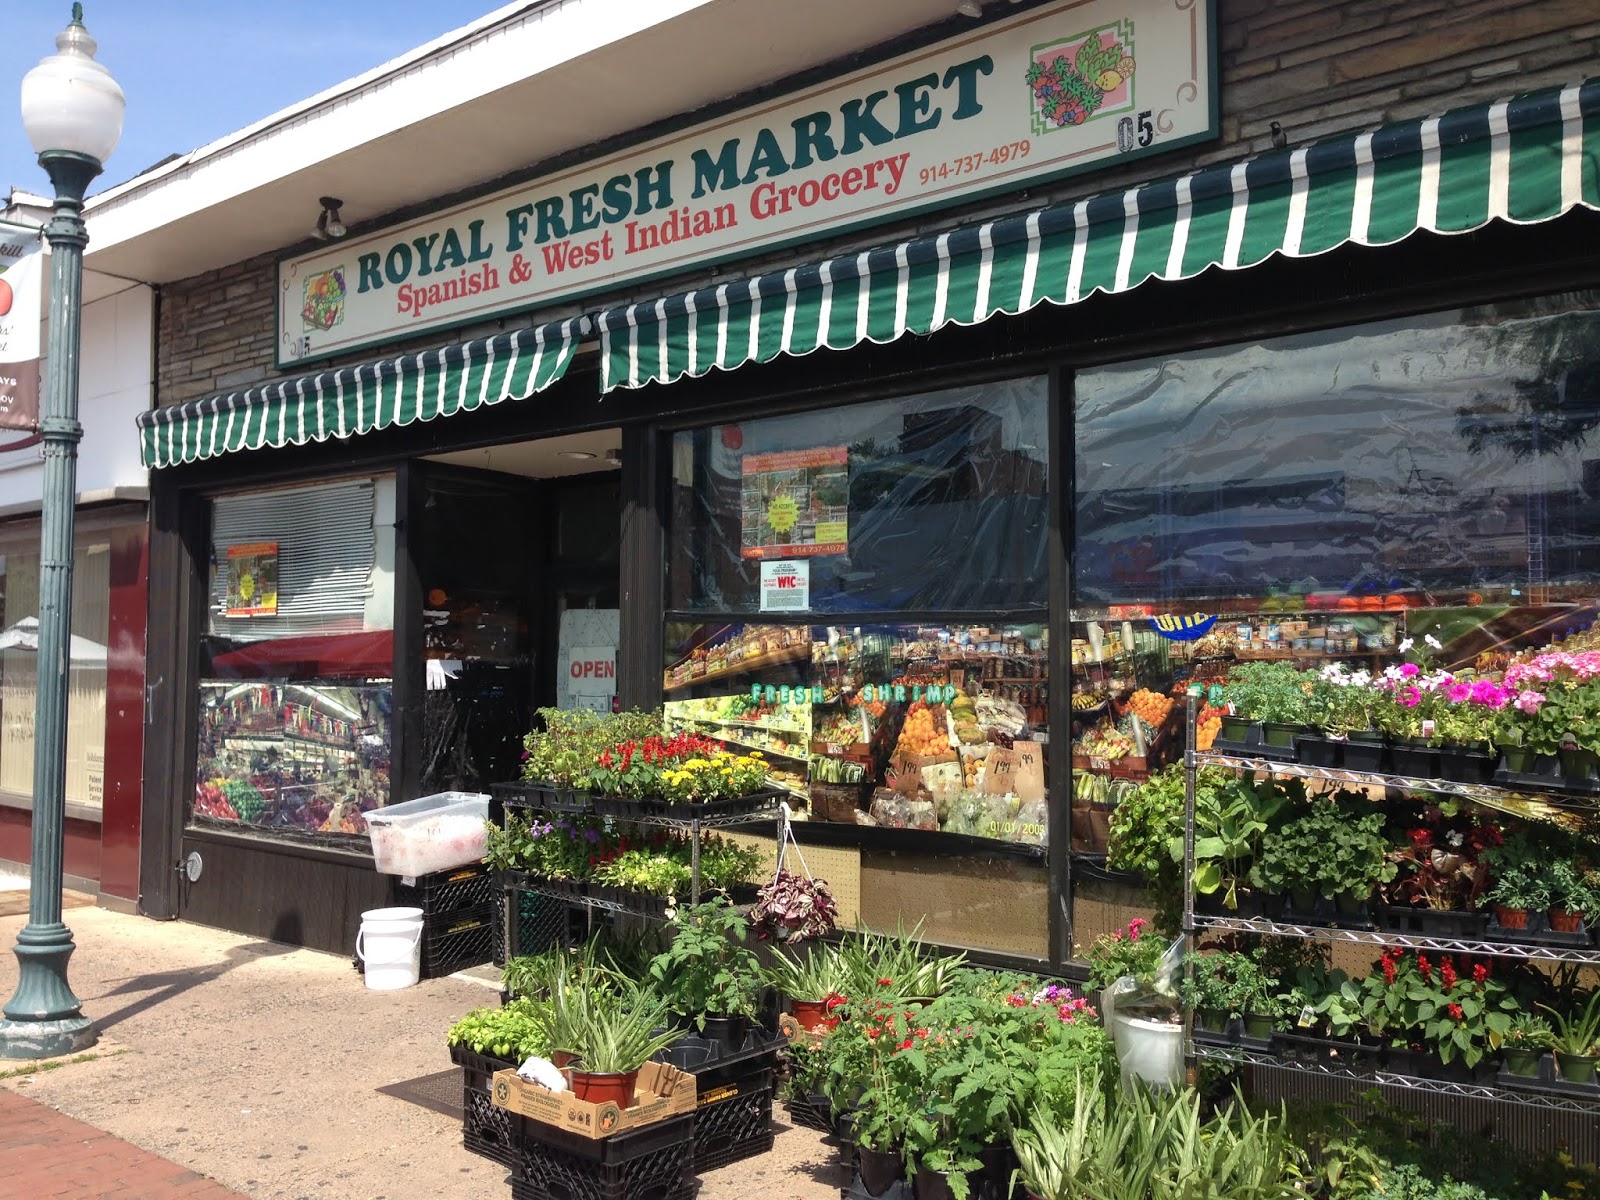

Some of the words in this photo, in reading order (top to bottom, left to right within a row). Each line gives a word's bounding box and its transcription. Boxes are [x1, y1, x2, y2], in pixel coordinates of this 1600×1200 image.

[357, 219, 493, 294] ROYAL
[506, 159, 674, 252] FRESH
[690, 54, 994, 199] MARKET
[397, 262, 500, 317] Spanish
[508, 253, 532, 284] &
[541, 230, 614, 275] West
[624, 203, 738, 255] Indian
[749, 152, 911, 220] Grocery
[920, 139, 1031, 185] 914-737-4979
[777, 576, 796, 588] WIC
[570, 660, 615, 679] OPEN
[751, 683, 825, 704] FRESH
[863, 683, 957, 705] SHRIMP
